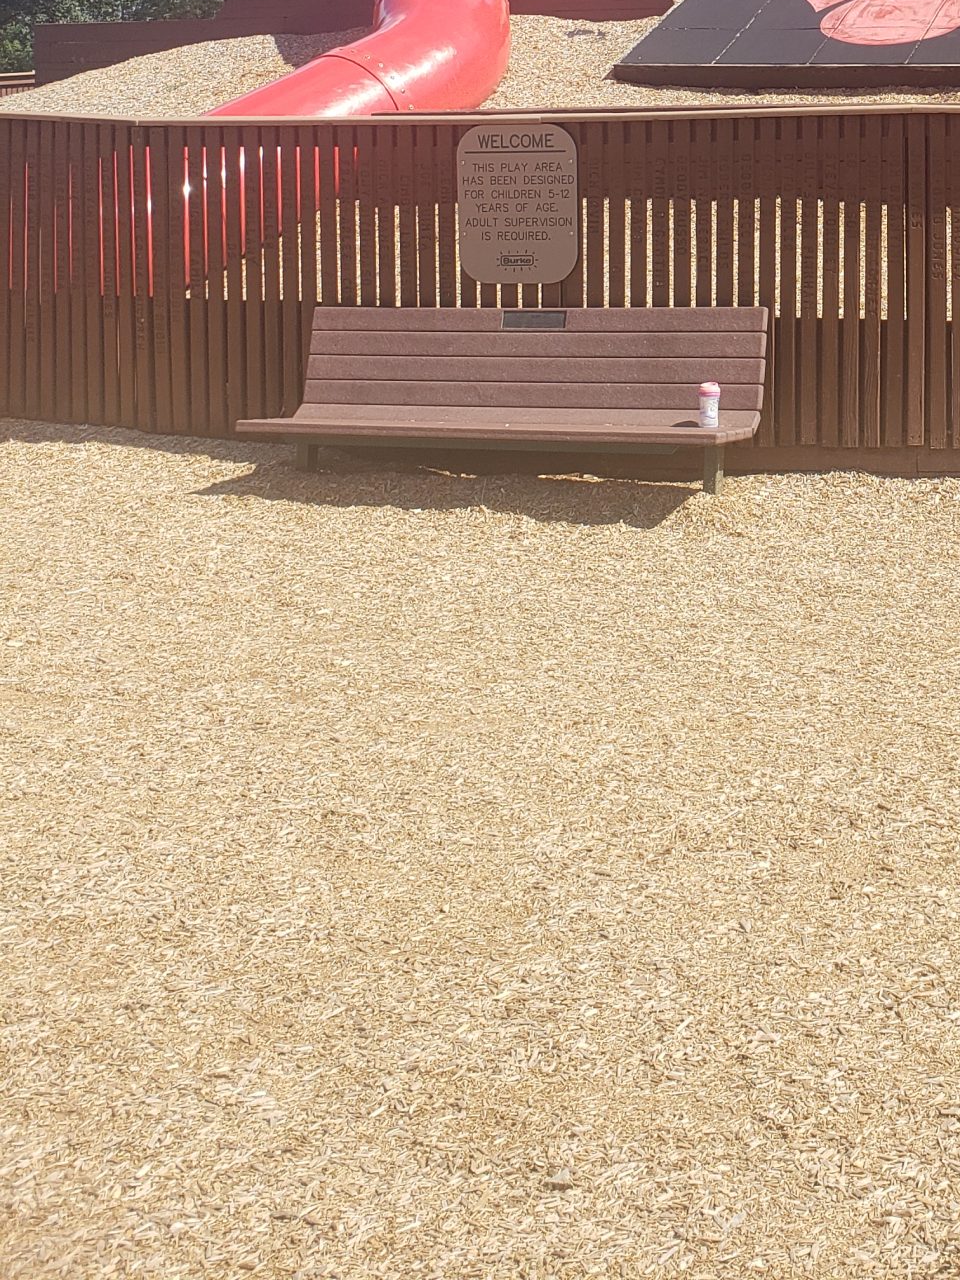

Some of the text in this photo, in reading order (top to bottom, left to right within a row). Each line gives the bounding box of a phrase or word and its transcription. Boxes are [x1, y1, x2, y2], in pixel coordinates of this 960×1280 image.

[477, 133, 555, 149] WELCOME
[472, 162, 563, 173] THIS PLAY AREA
[462, 175, 575, 185] HAS BEEN DESIGNED
[464, 189, 570, 199] FOR CHILDREN 5-12
[475, 203, 559, 213] YEARS OF AGE.
[465, 217, 573, 227] ADULT SUPERVISION
[481, 231, 551, 241] IS REQUIRED.
[503, 256, 532, 264] Burke
